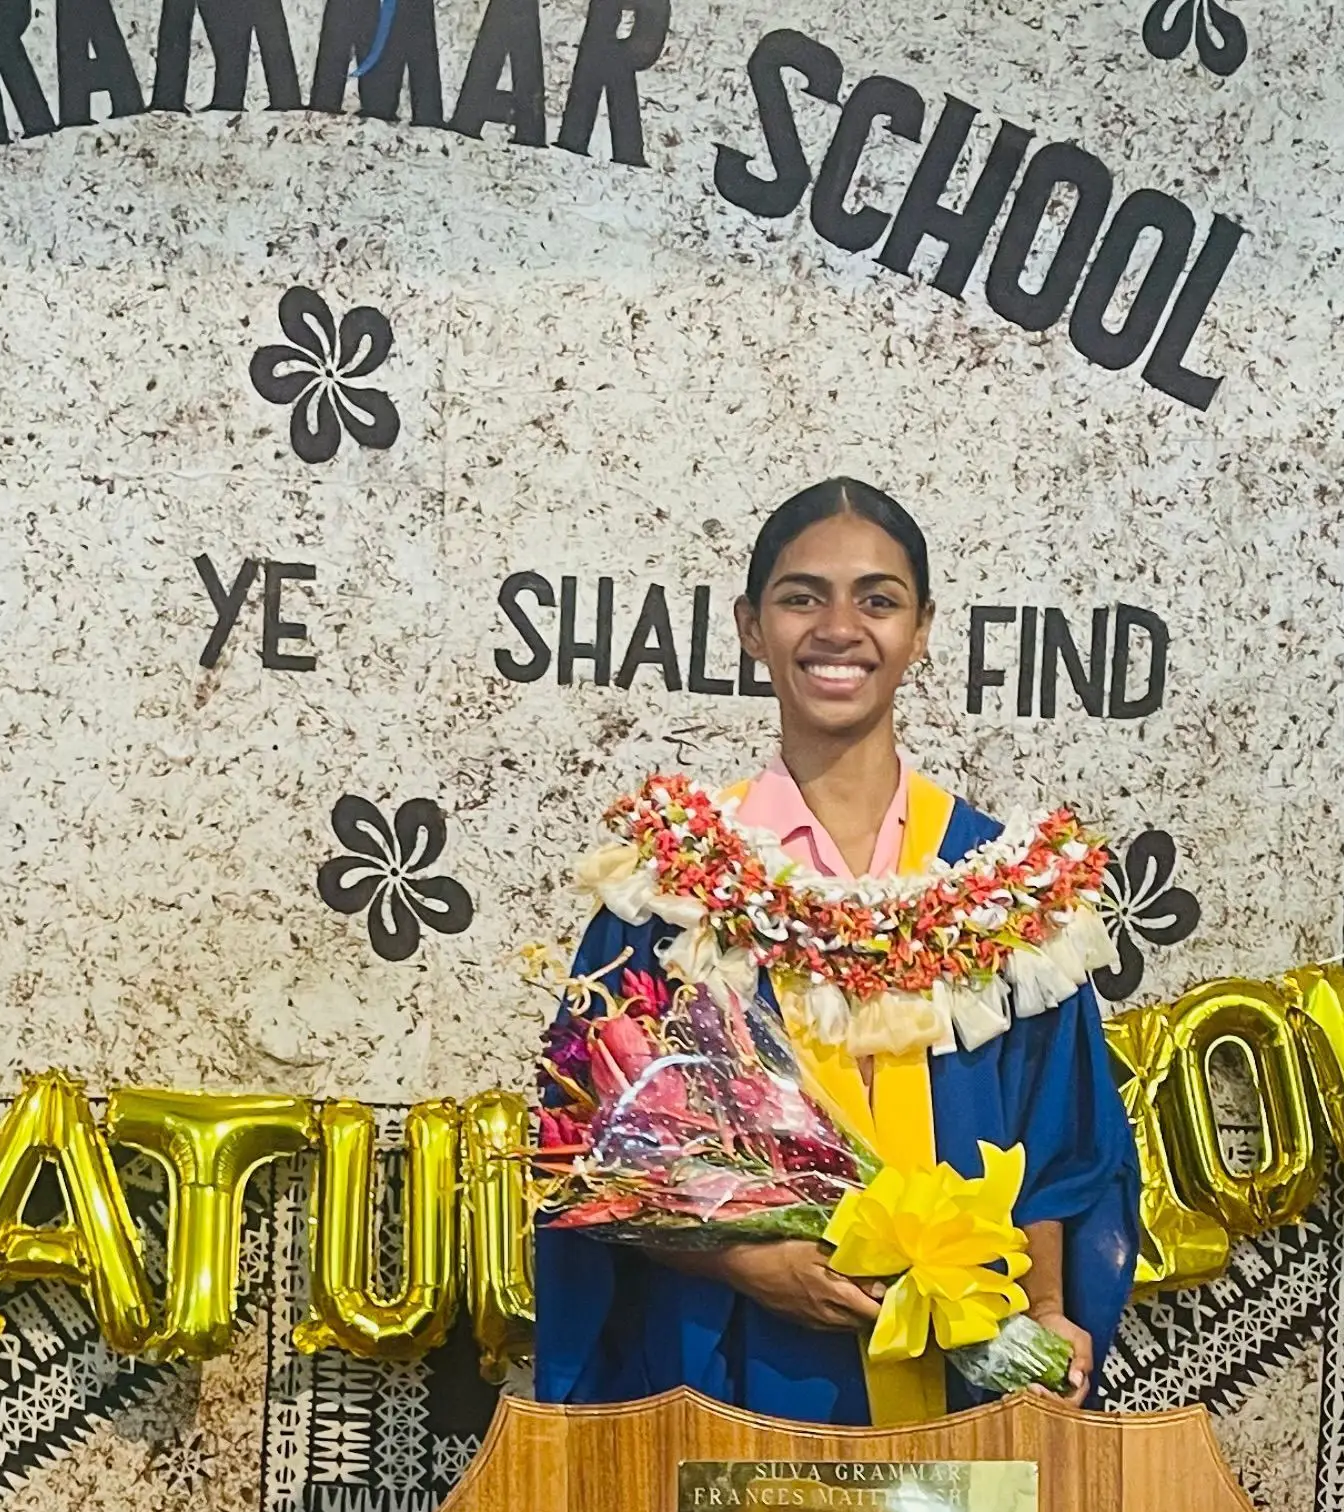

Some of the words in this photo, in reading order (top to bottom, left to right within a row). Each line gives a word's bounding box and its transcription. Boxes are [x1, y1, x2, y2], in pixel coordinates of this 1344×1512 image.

[716, 27, 1253, 410] SCHOOL
[196, 553, 318, 673] YE
[967, 603, 1170, 719] FIND
[694, 1488, 804, 1506] FRANCES
[755, 1463, 821, 1481] SUVA
[835, 1464, 961, 1481] GRAMMAR
